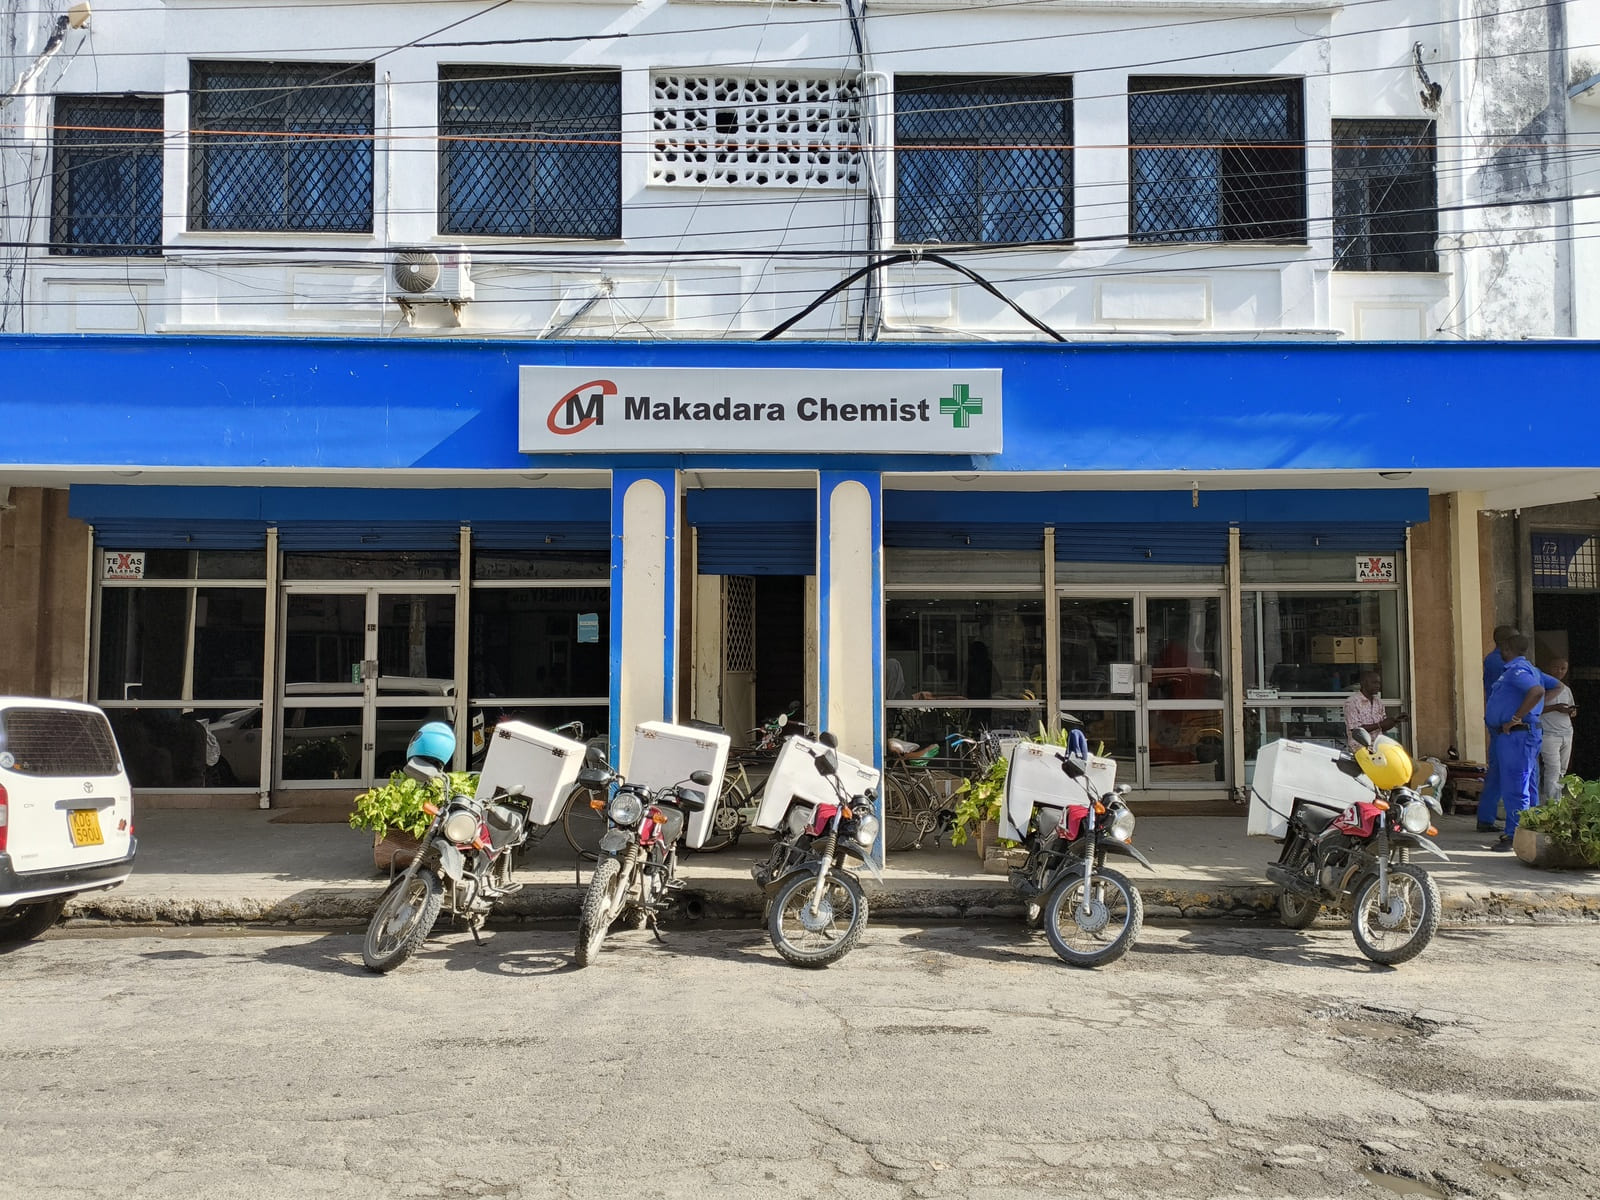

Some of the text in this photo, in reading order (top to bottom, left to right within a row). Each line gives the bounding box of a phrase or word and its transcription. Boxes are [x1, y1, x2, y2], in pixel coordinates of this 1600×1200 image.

[624, 396, 930, 423] Makadara Chemist
[106, 554, 142, 569] TEXAS
[1357, 557, 1393, 573] TEXAS
[107, 566, 141, 574] ALARMS
[73, 812, 91, 828] KDG
[76, 828, 101, 842] 590U
